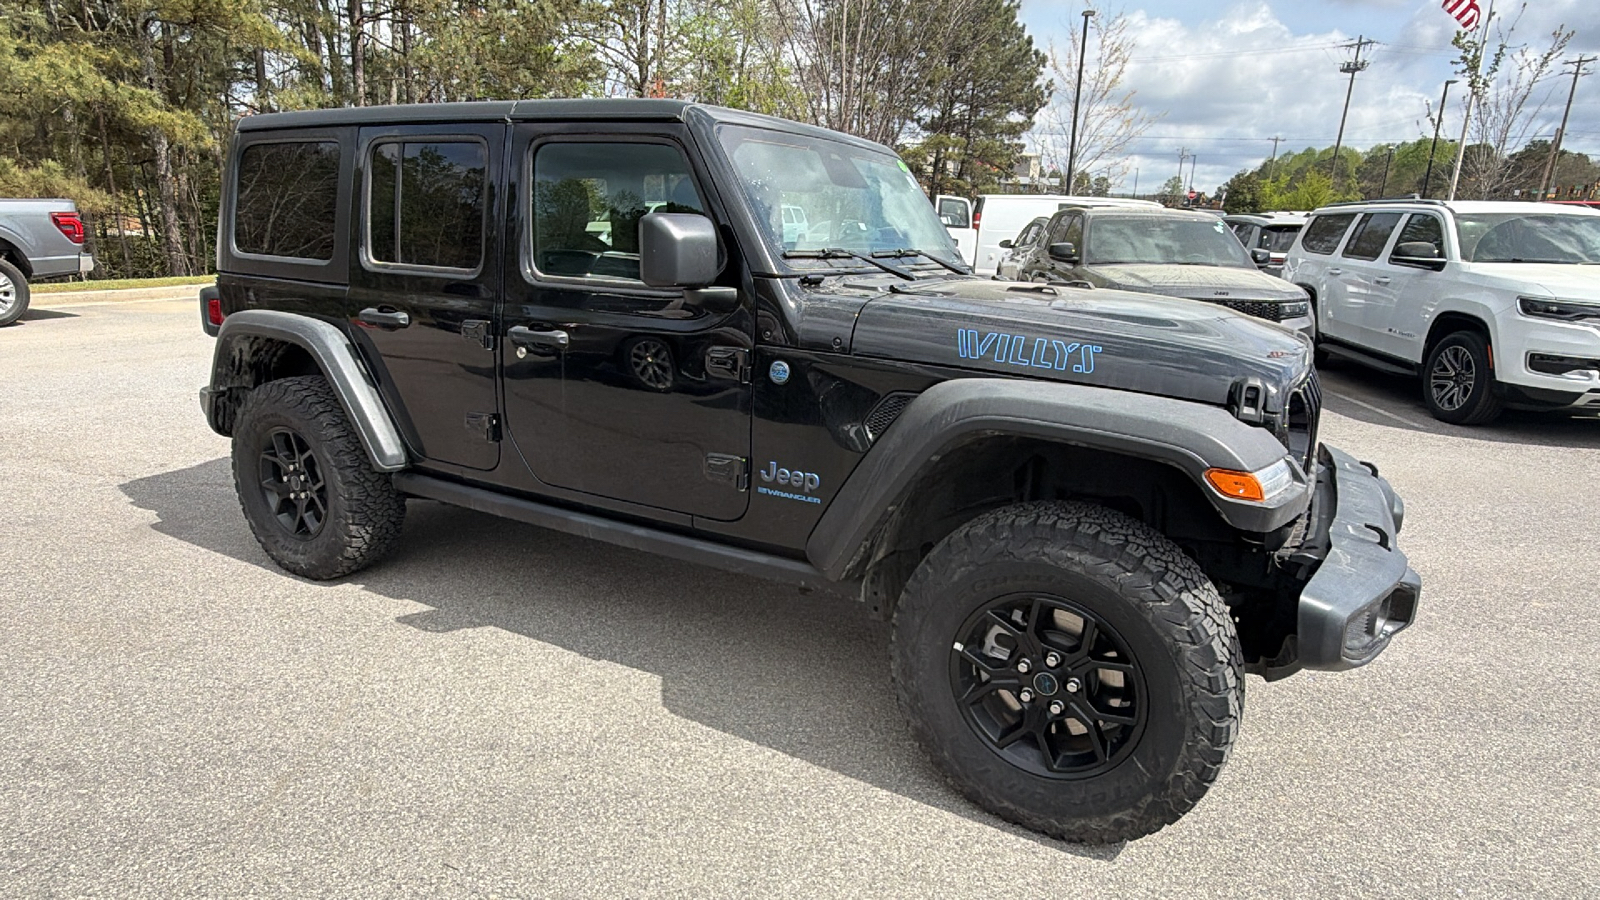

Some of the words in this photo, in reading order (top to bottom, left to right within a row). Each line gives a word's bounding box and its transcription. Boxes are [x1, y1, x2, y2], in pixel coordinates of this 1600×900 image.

[957, 328, 1103, 374] WILLYS
[760, 461, 820, 493] Jeep
[766, 488, 821, 504] WRANGLER
